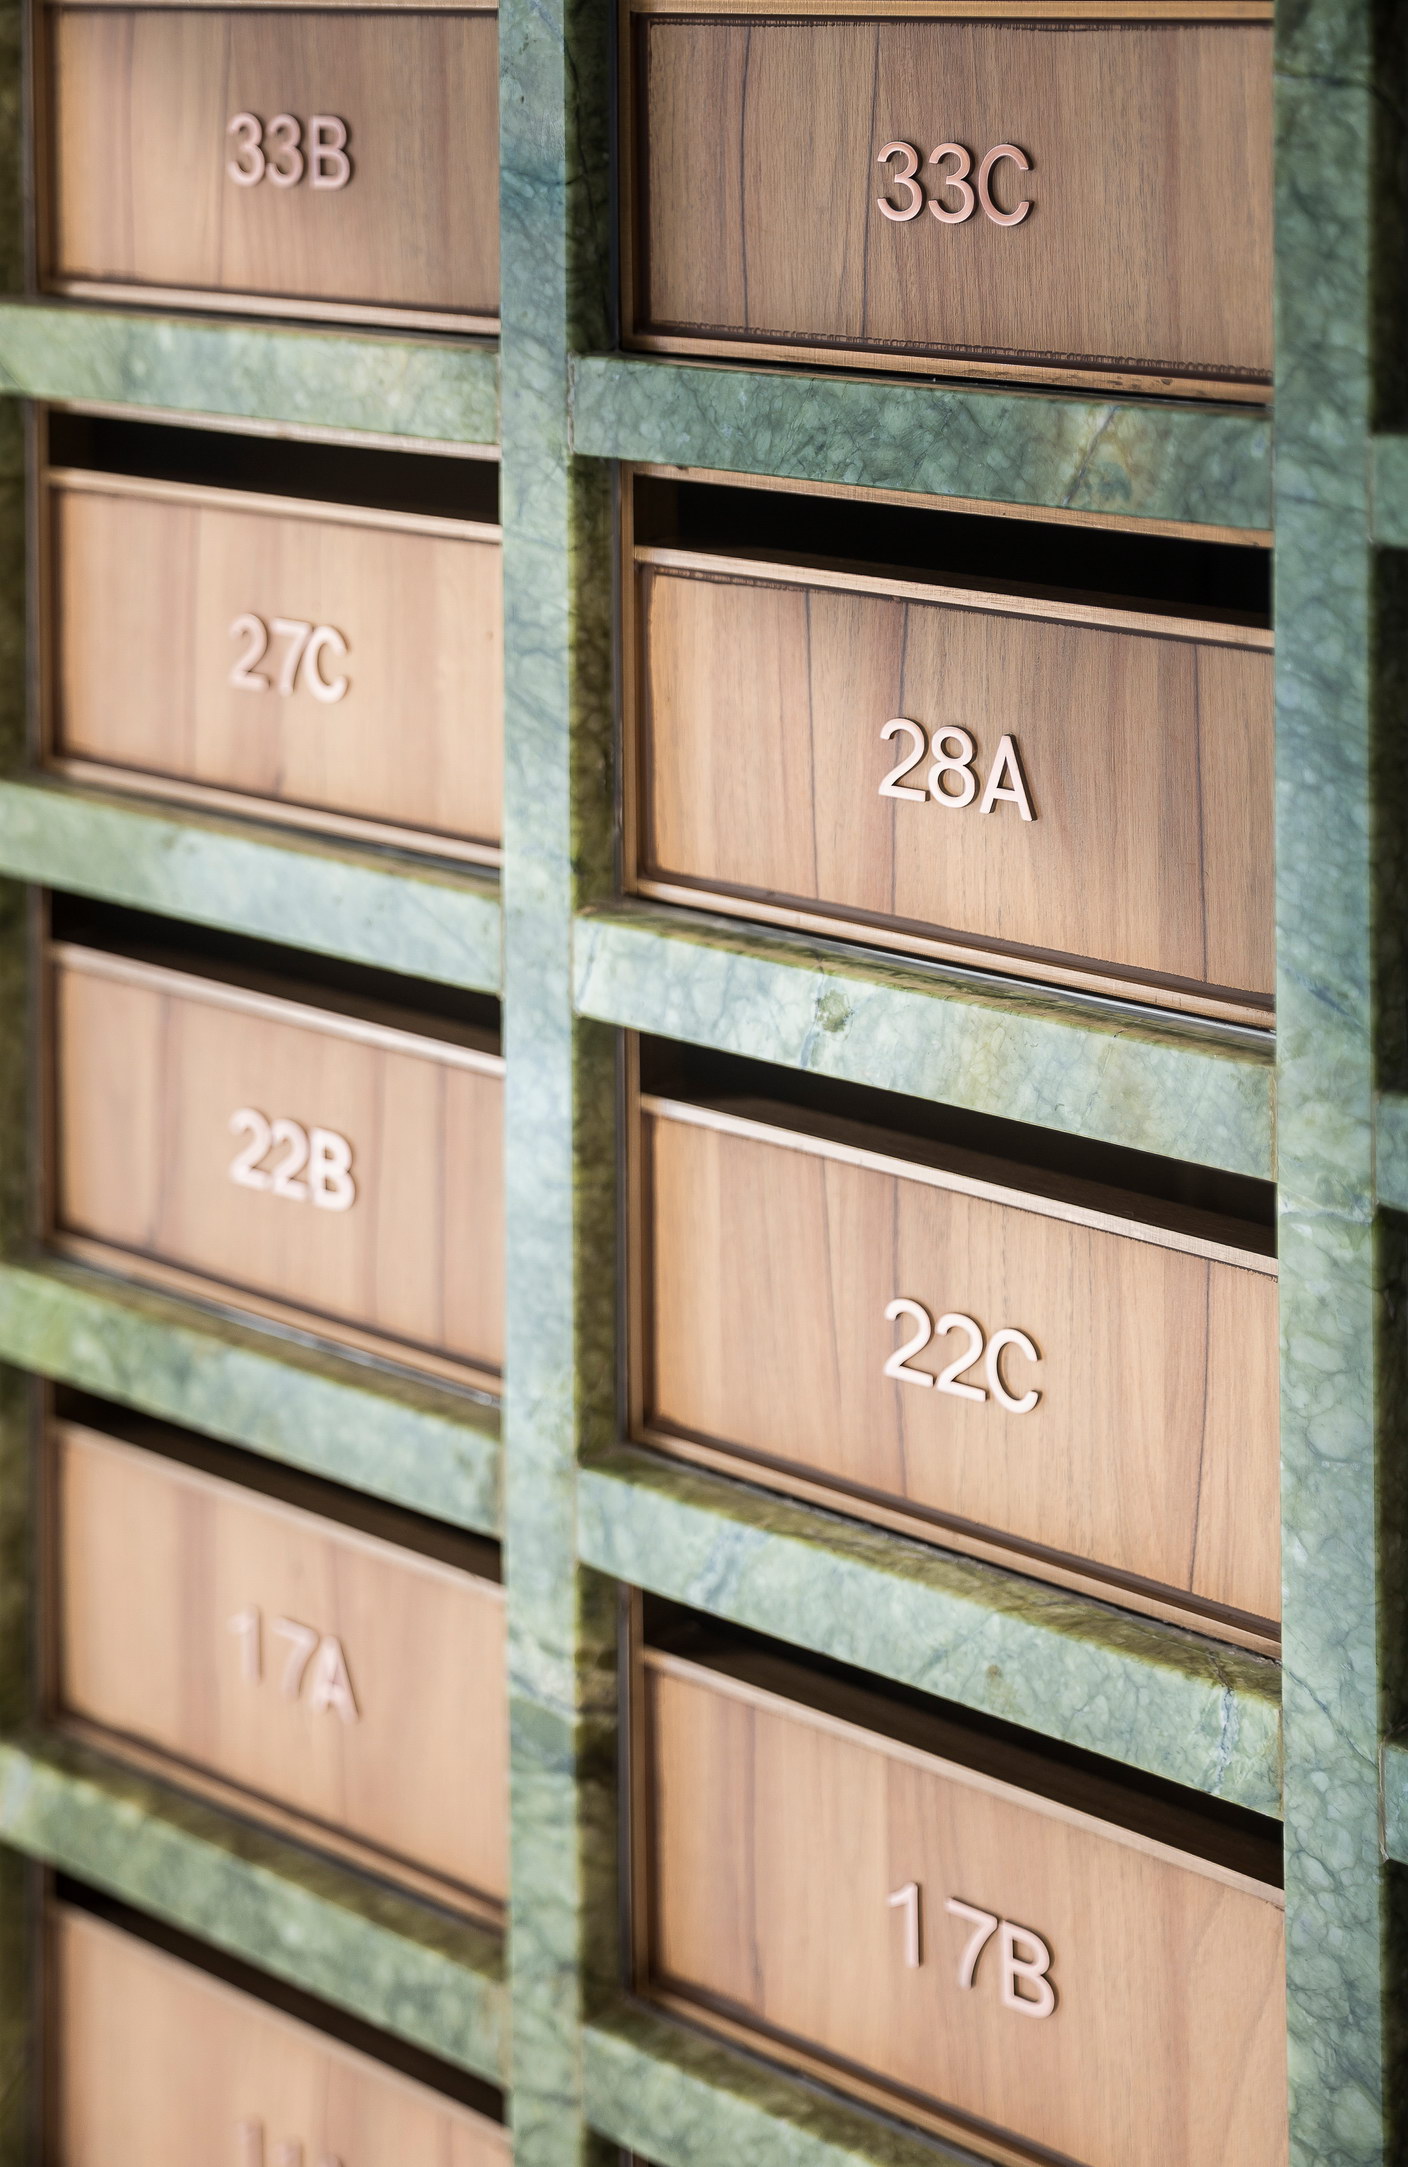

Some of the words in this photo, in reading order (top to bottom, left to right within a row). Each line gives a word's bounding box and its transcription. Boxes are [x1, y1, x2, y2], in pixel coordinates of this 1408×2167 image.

[228, 111, 353, 190] 33B
[876, 140, 1031, 228] 33C
[230, 613, 350, 704] 27C
[879, 717, 1036, 823] 28A
[230, 1107, 355, 1213] 22B
[884, 1297, 1040, 1414] 22C
[229, 1608, 361, 1723] 17A
[888, 1882, 1057, 2019] 17B
